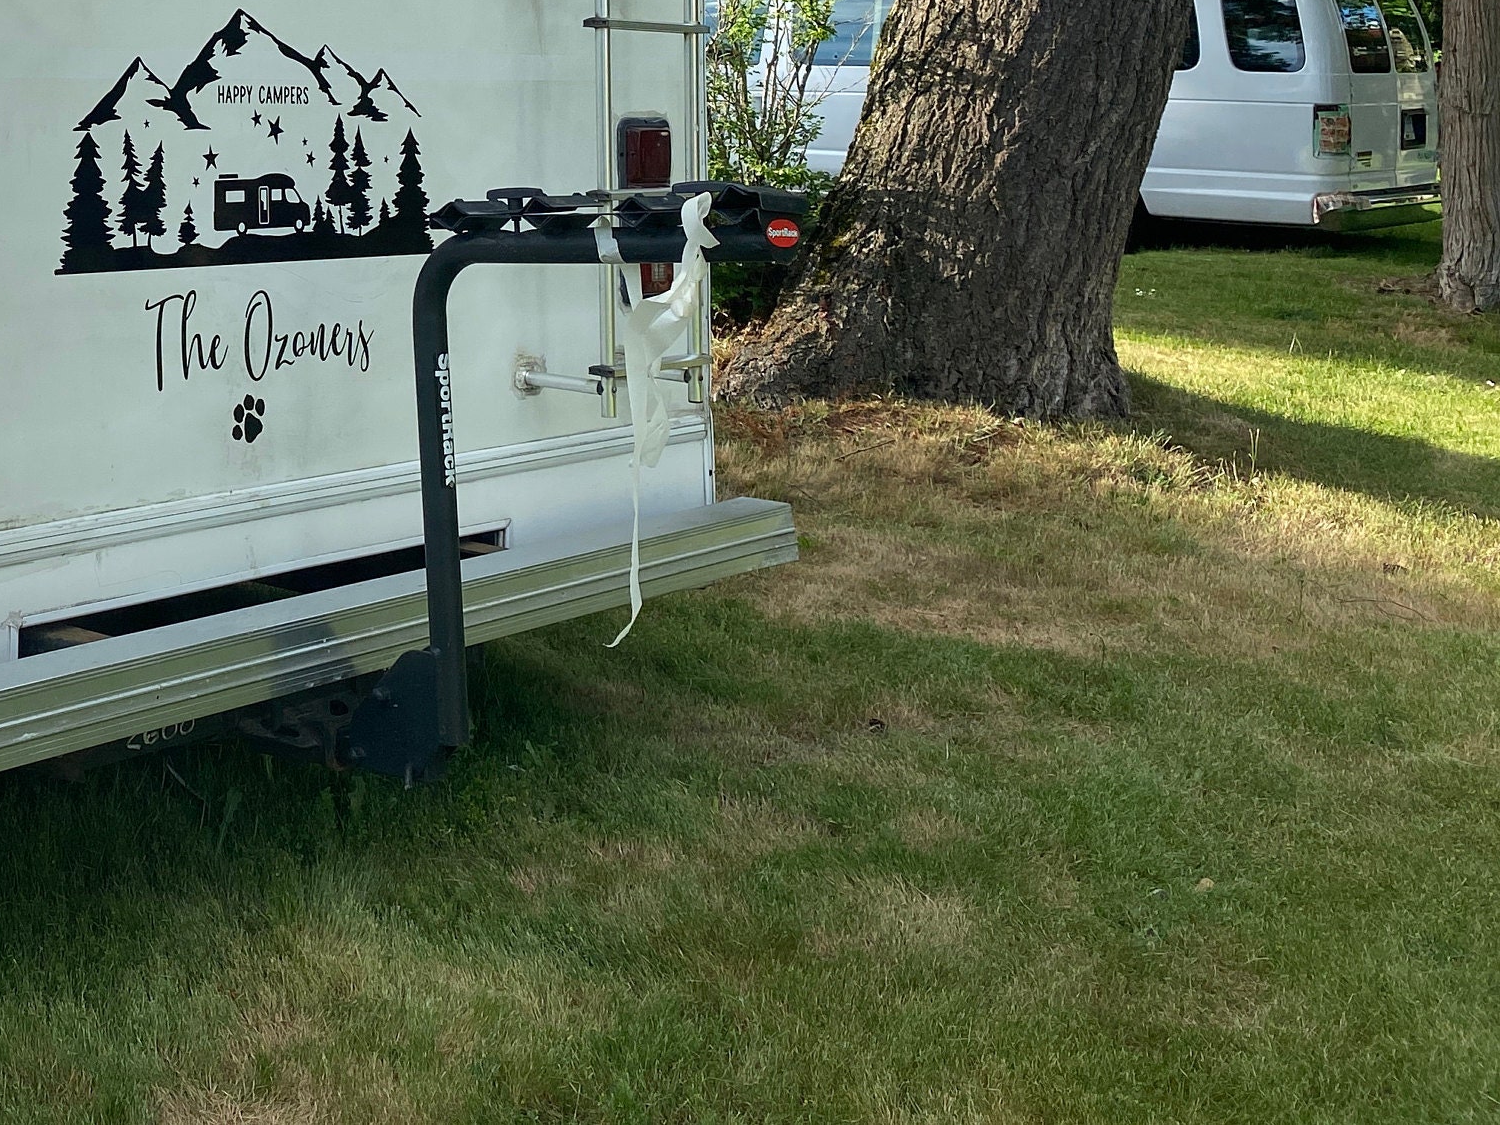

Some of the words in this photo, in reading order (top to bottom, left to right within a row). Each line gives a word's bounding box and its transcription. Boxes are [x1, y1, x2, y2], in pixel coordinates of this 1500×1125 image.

[217, 85, 253, 105] HAPPY
[258, 85, 309, 105] CAMPERS
[145, 289, 229, 392] The
[243, 289, 375, 382] Ozoners
